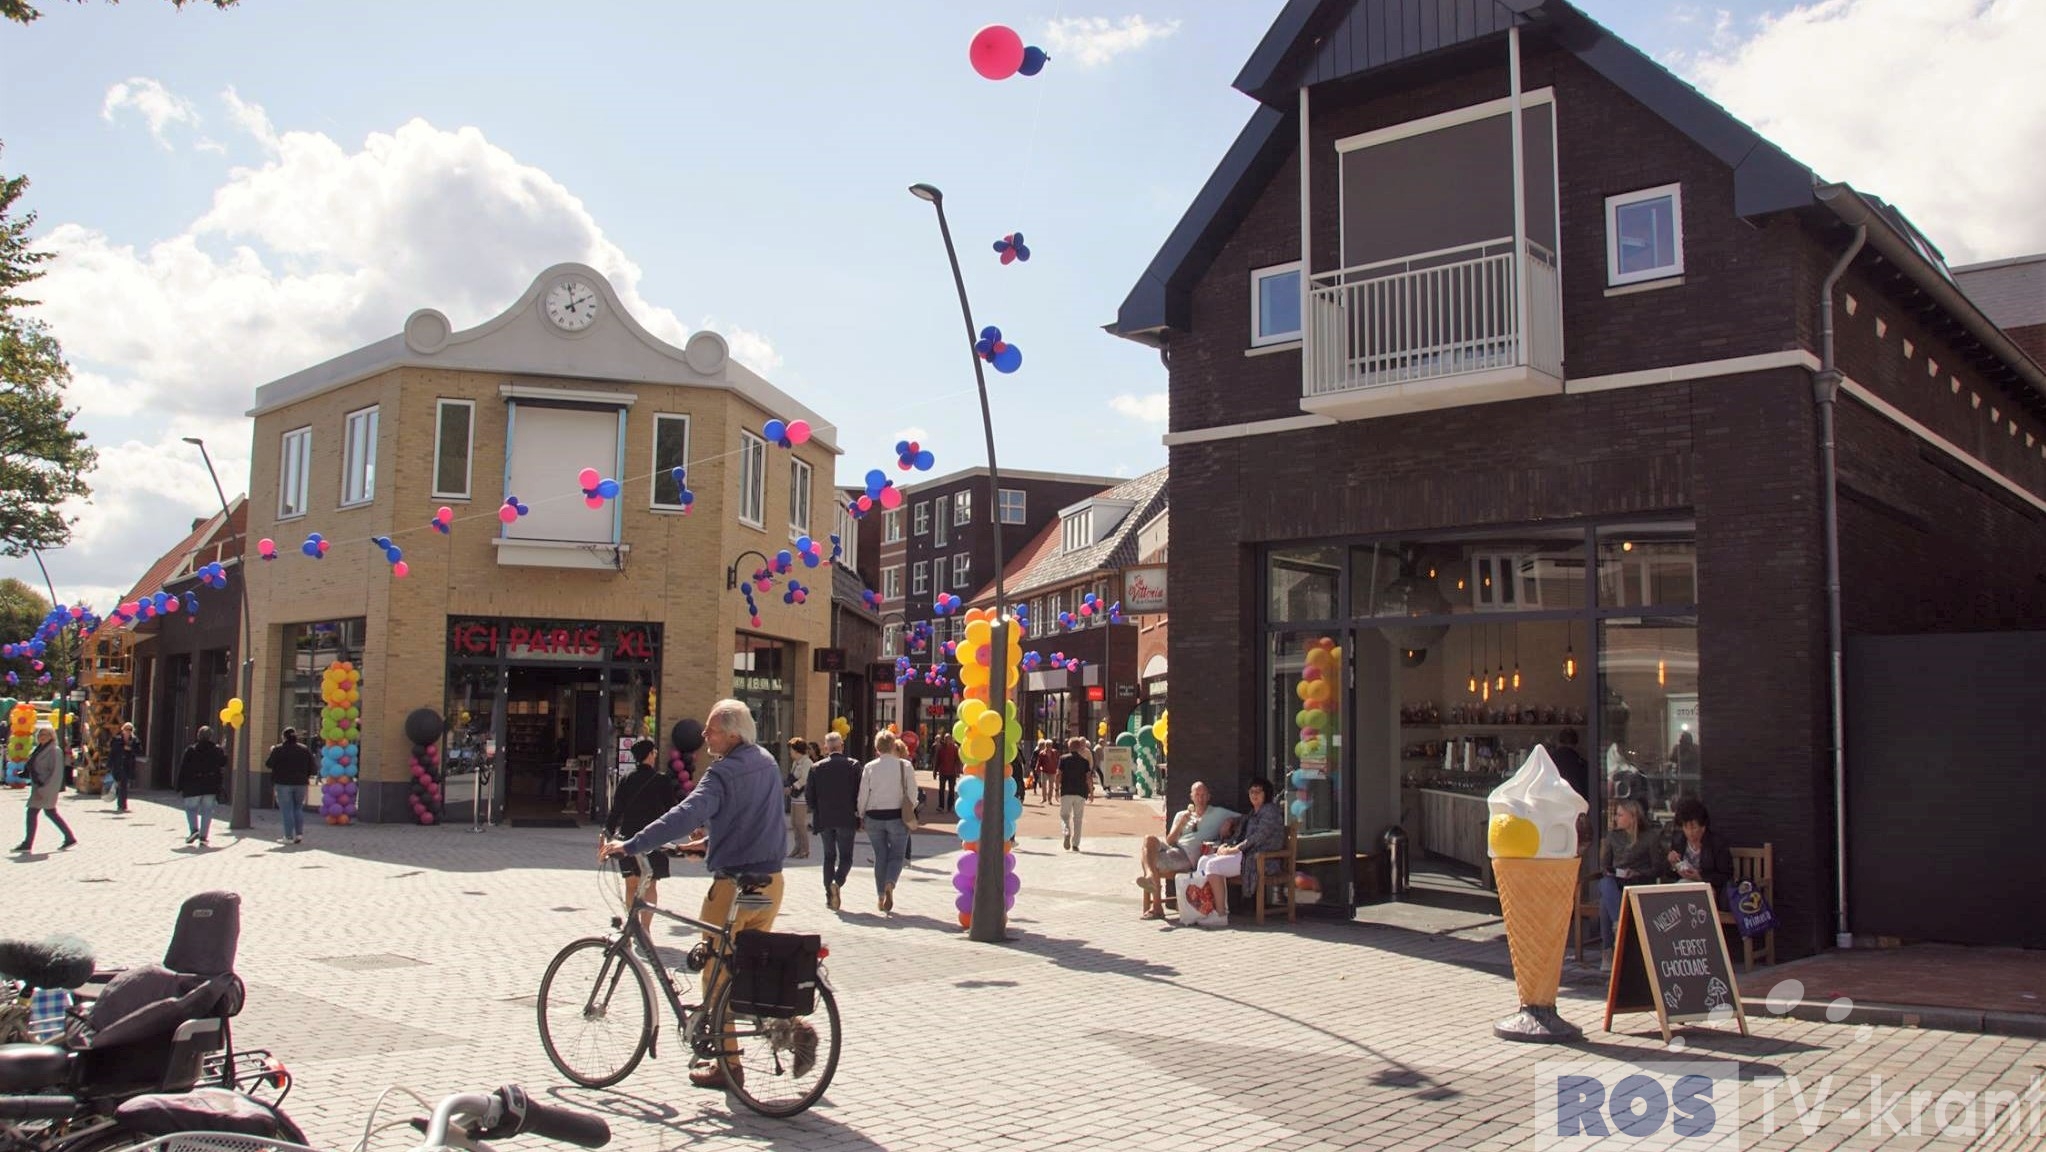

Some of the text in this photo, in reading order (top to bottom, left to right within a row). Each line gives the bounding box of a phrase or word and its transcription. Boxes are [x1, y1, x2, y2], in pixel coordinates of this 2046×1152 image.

[453, 623, 653, 657] ICI PARIS XL
[1653, 904, 1681, 931] NIEUW
[1672, 938, 1707, 956] HERFST
[1661, 958, 1711, 978] CHOCOLADE
